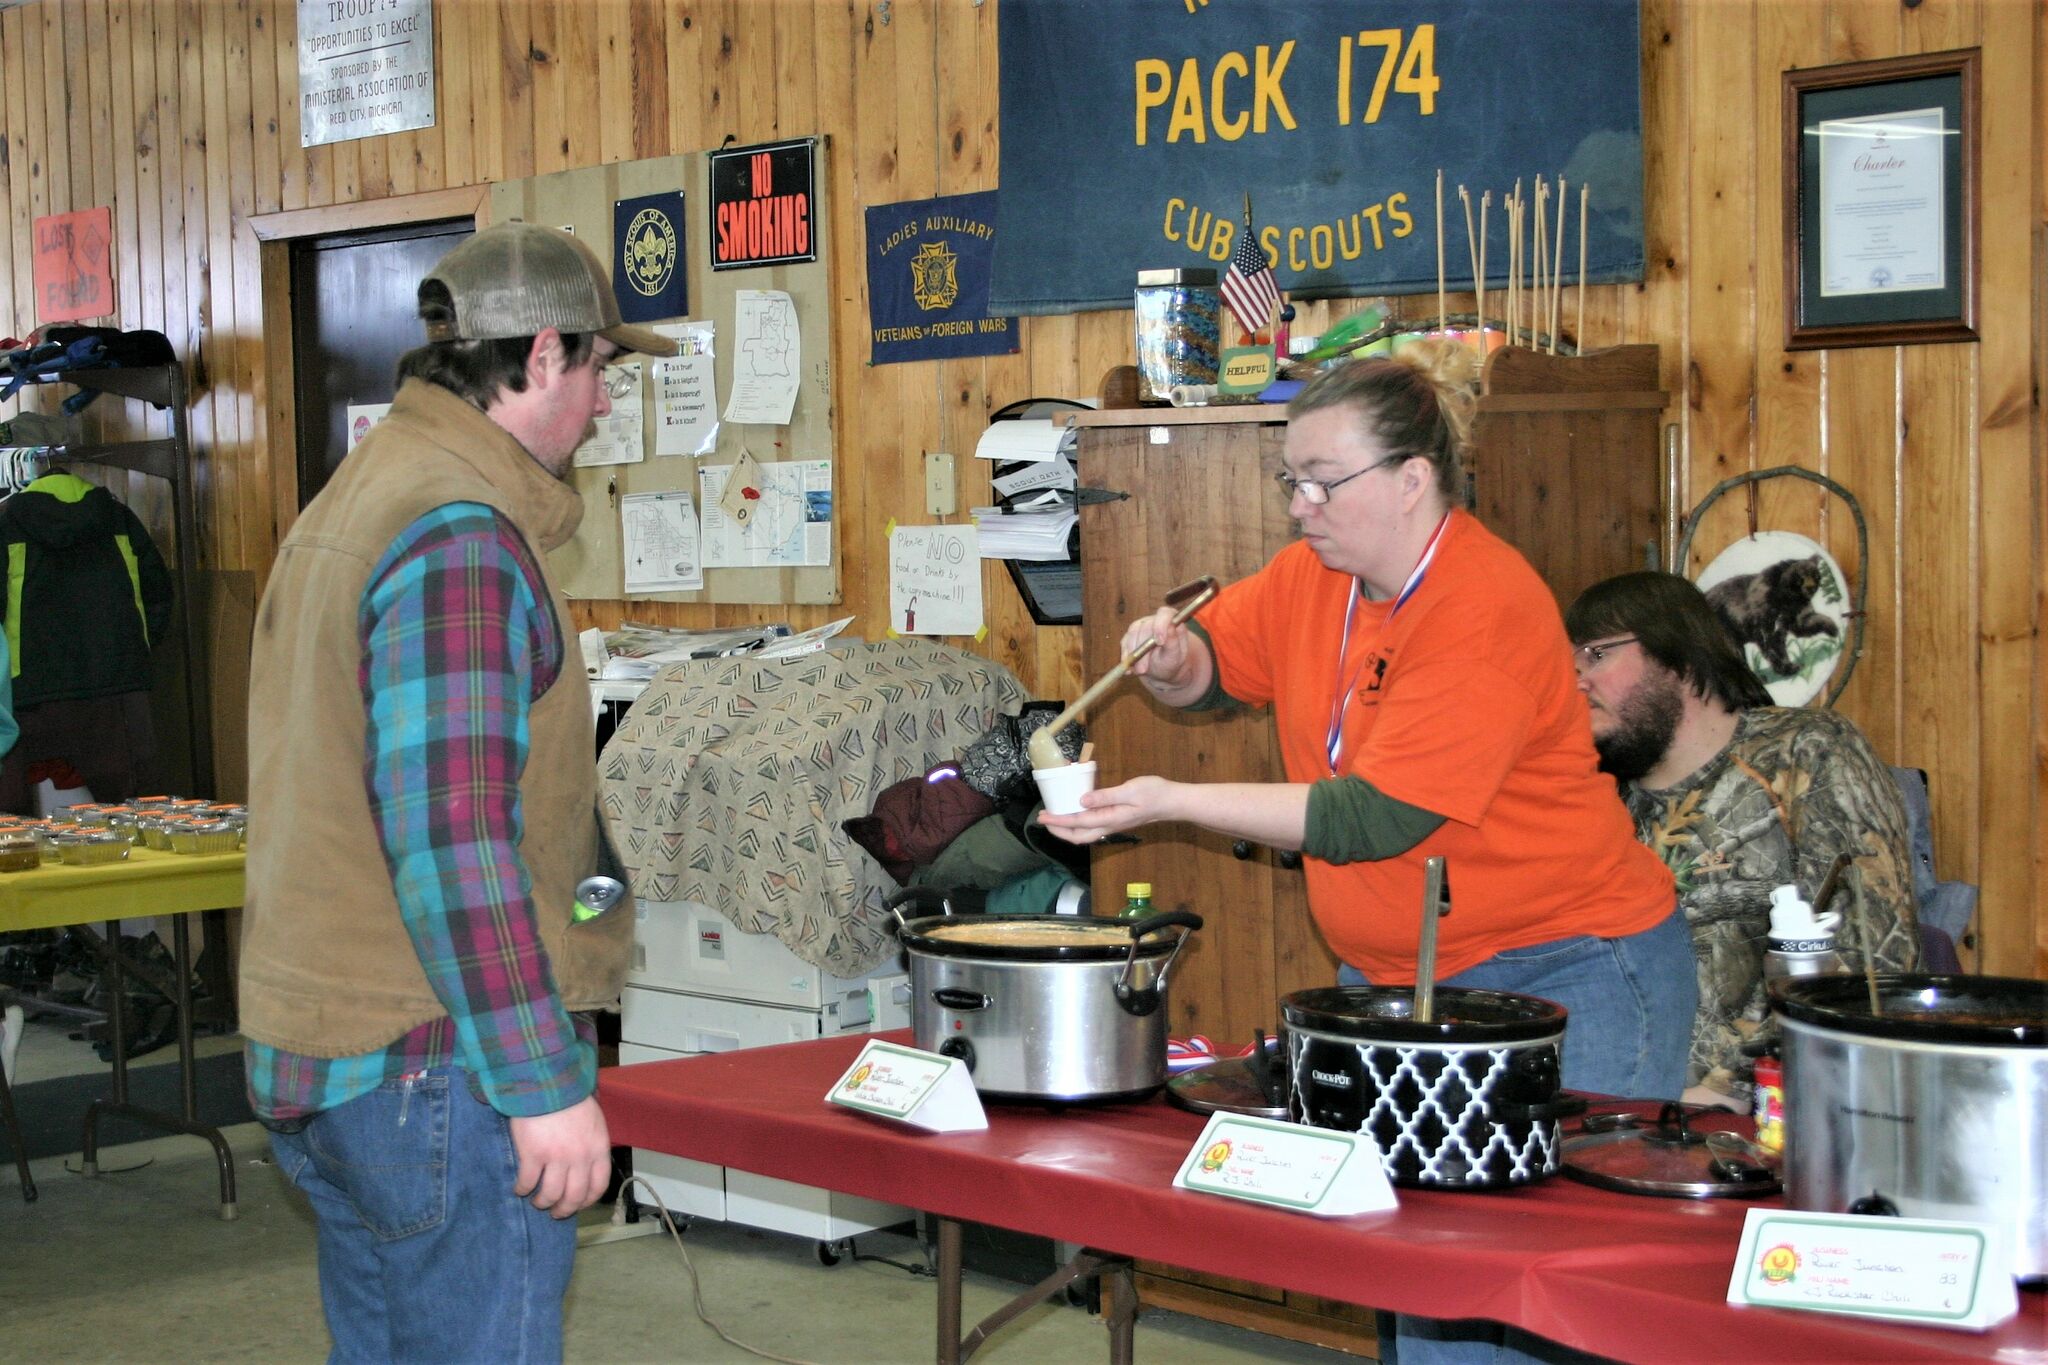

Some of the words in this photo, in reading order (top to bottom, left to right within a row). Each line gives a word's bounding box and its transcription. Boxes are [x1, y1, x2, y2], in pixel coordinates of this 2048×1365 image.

[376, 23, 387, 38] TO
[391, 14, 421, 35] EXCEL"
[331, 62, 370, 80] SPONSORED
[373, 60, 382, 72] BY
[385, 56, 398, 69] THE
[304, 86, 355, 109] MINISTERIAL
[358, 74, 414, 99] ASSOCIATION
[417, 72, 429, 88] OF
[1136, 40, 1297, 146] PACK
[1338, 24, 1440, 126] 174
[329, 112, 347, 125] REED
[349, 108, 367, 122] CITY,
[368, 101, 403, 119] MICHIGAN
[1853, 154, 1905, 172] Charter
[752, 153, 772, 198] NO
[649, 211, 659, 221] OF
[718, 193, 808, 261] SMOKING
[627, 213, 646, 246] SCOUTS
[880, 221, 917, 256] LADIES
[926, 216, 994, 240] AUXILIARY
[1164, 198, 1235, 262] CUB
[1259, 192, 1414, 271] SCOUTS
[660, 219, 676, 269] AMERICA
[625, 252, 635, 274] BOY
[932, 320, 974, 337] FOREIGN
[979, 318, 1007, 333] WARS
[1226, 364, 1267, 376] HELPFUL
[1009, 477, 1037, 489] SCOUT
[1040, 471, 1061, 481] OATH
[897, 533, 923, 548] Please
[927, 532, 964, 564] NO
[949, 569, 959, 581] by
[1798, 941, 1827, 951] Cirkul
